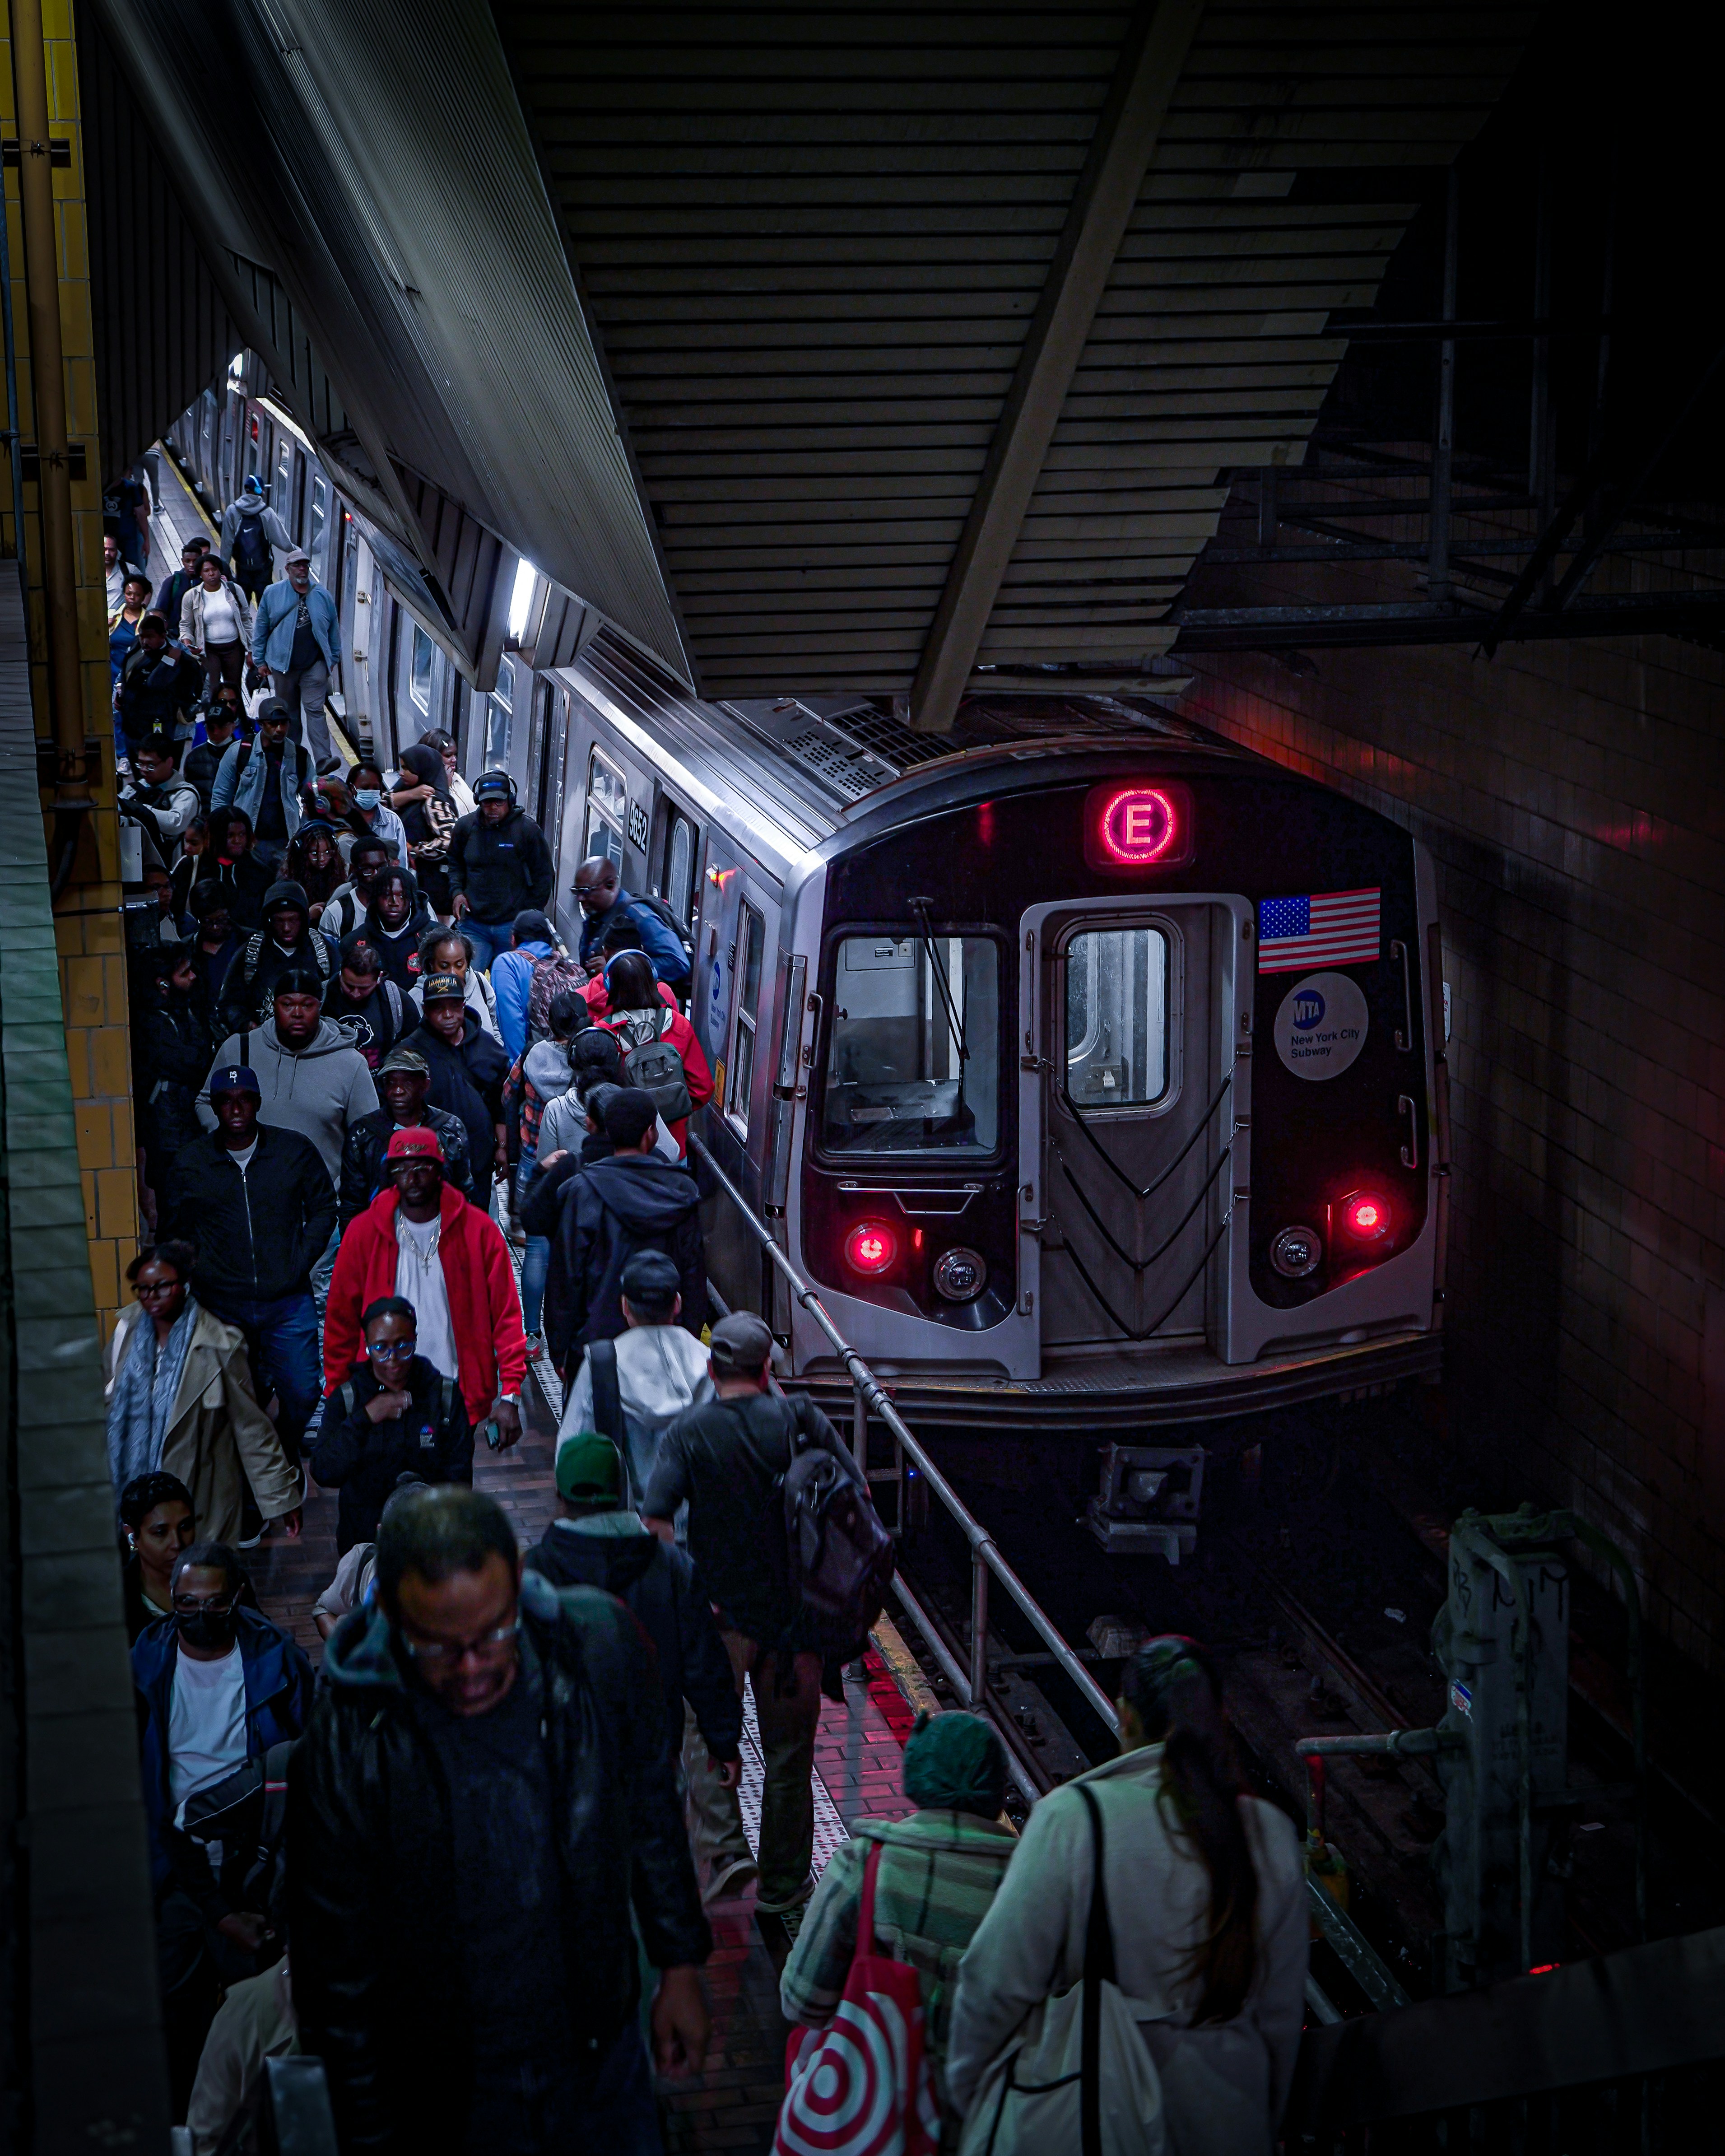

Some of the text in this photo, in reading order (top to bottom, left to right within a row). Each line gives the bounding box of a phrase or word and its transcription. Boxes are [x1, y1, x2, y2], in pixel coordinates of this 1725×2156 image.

[629, 799, 647, 853] 9652
[1126, 804, 1151, 844] E
[1293, 999, 1320, 1022] MTA
[1291, 1028, 1360, 1046] New York City
[1291, 1047, 1331, 1058] Subway
